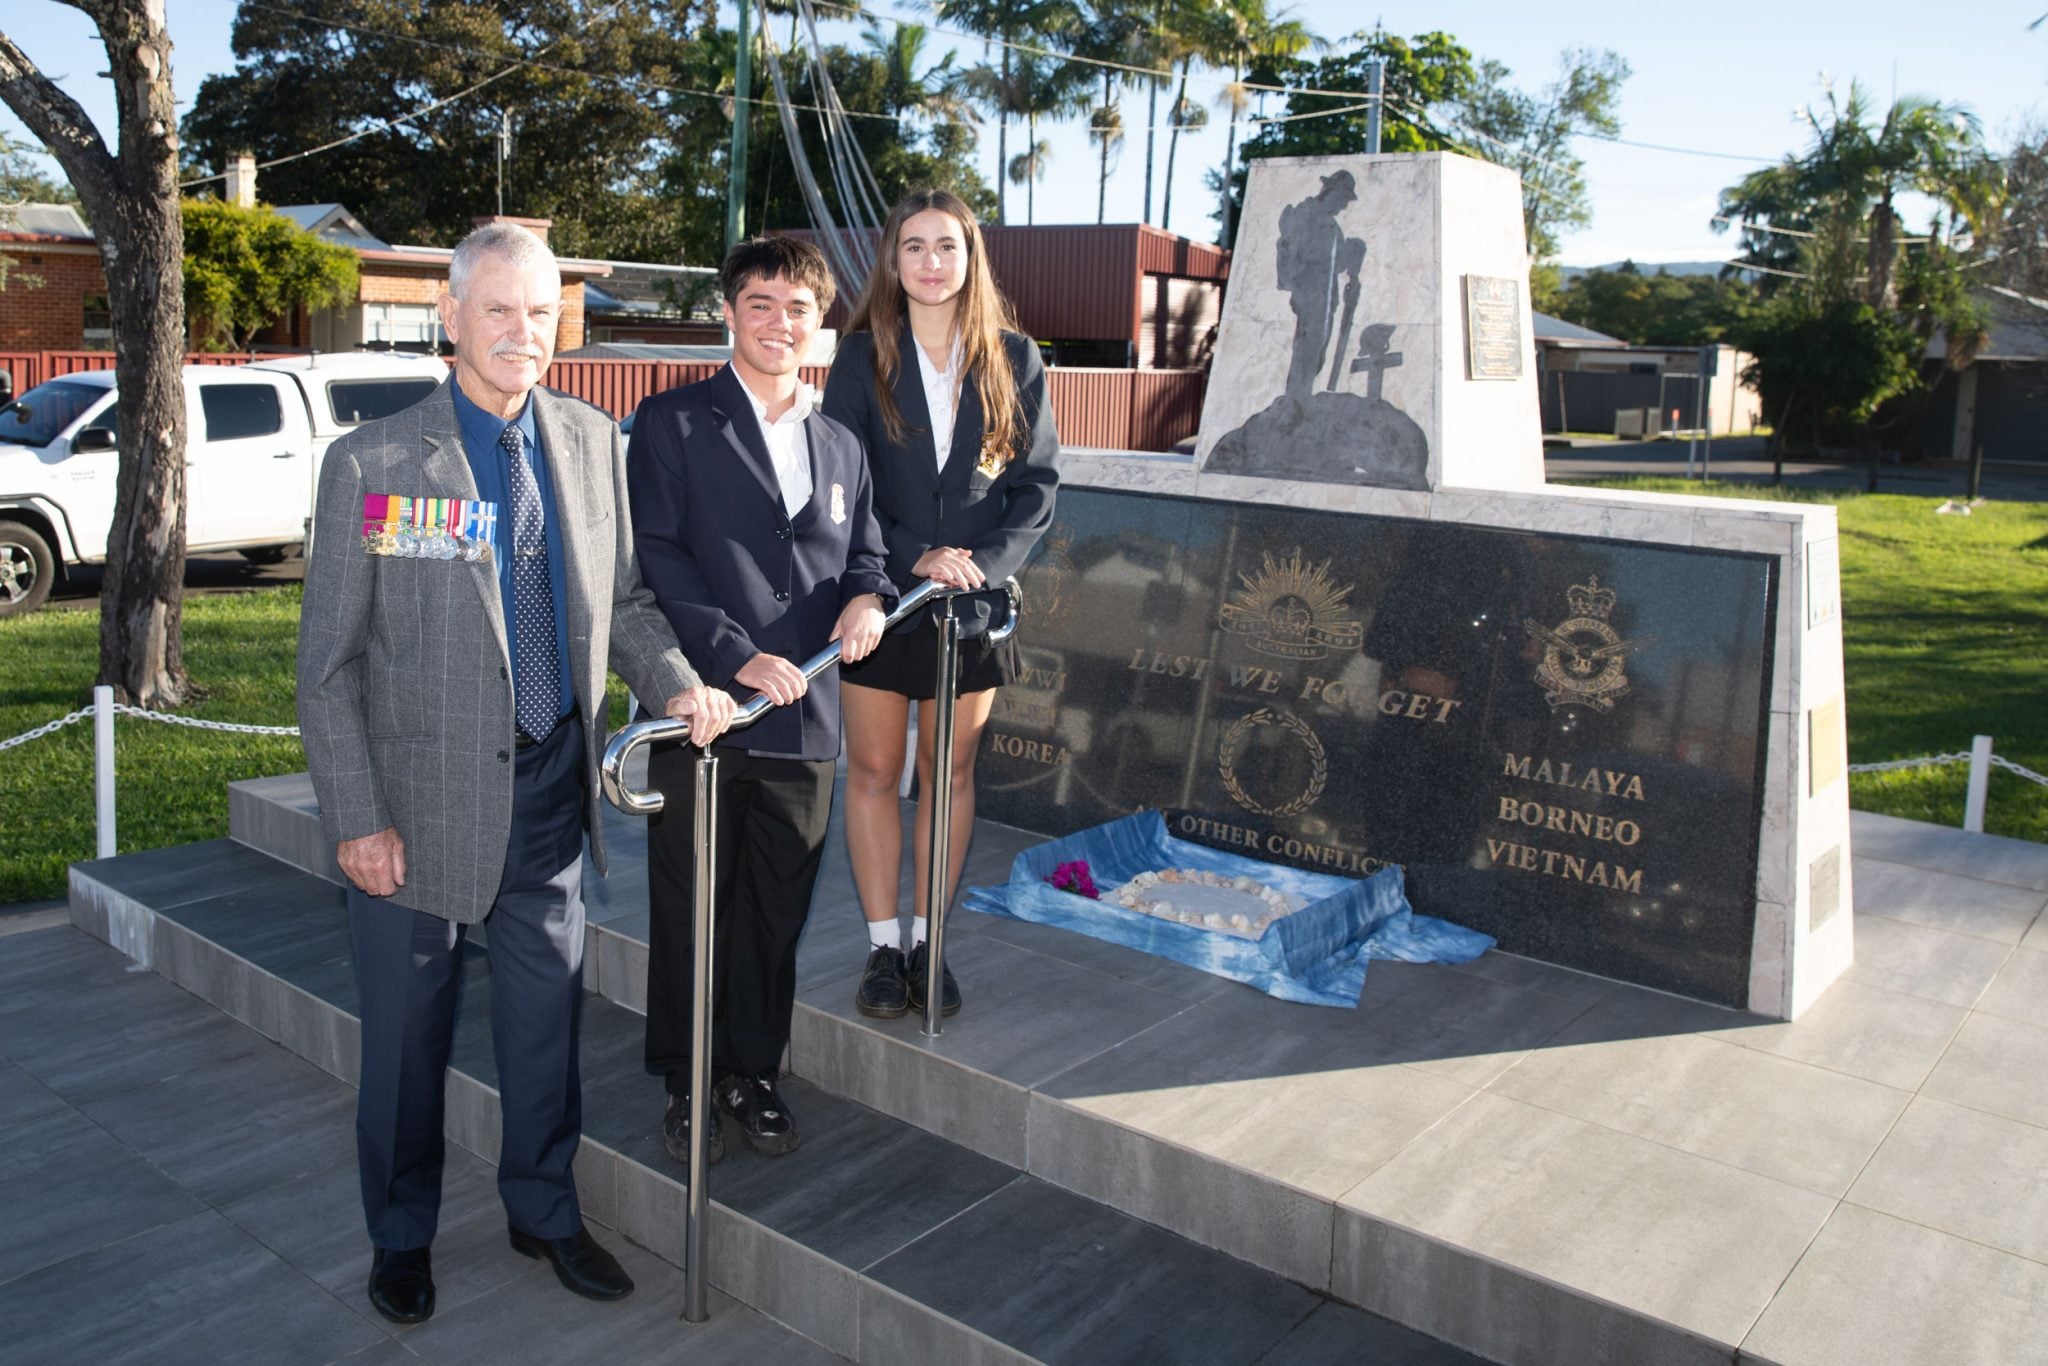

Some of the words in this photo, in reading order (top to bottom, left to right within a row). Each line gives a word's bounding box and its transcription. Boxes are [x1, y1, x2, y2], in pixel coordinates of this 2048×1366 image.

[1128, 648, 1214, 680] LEST
[1229, 664, 1282, 694] WE
[991, 733, 1072, 767] KOREA
[1503, 753, 1645, 801] MALAYA
[1180, 815, 1260, 849] OTHER
[1266, 835, 1407, 876] CONFLIC
[1498, 796, 1641, 846] BORNEO
[1486, 838, 1644, 895] VIETNAM
